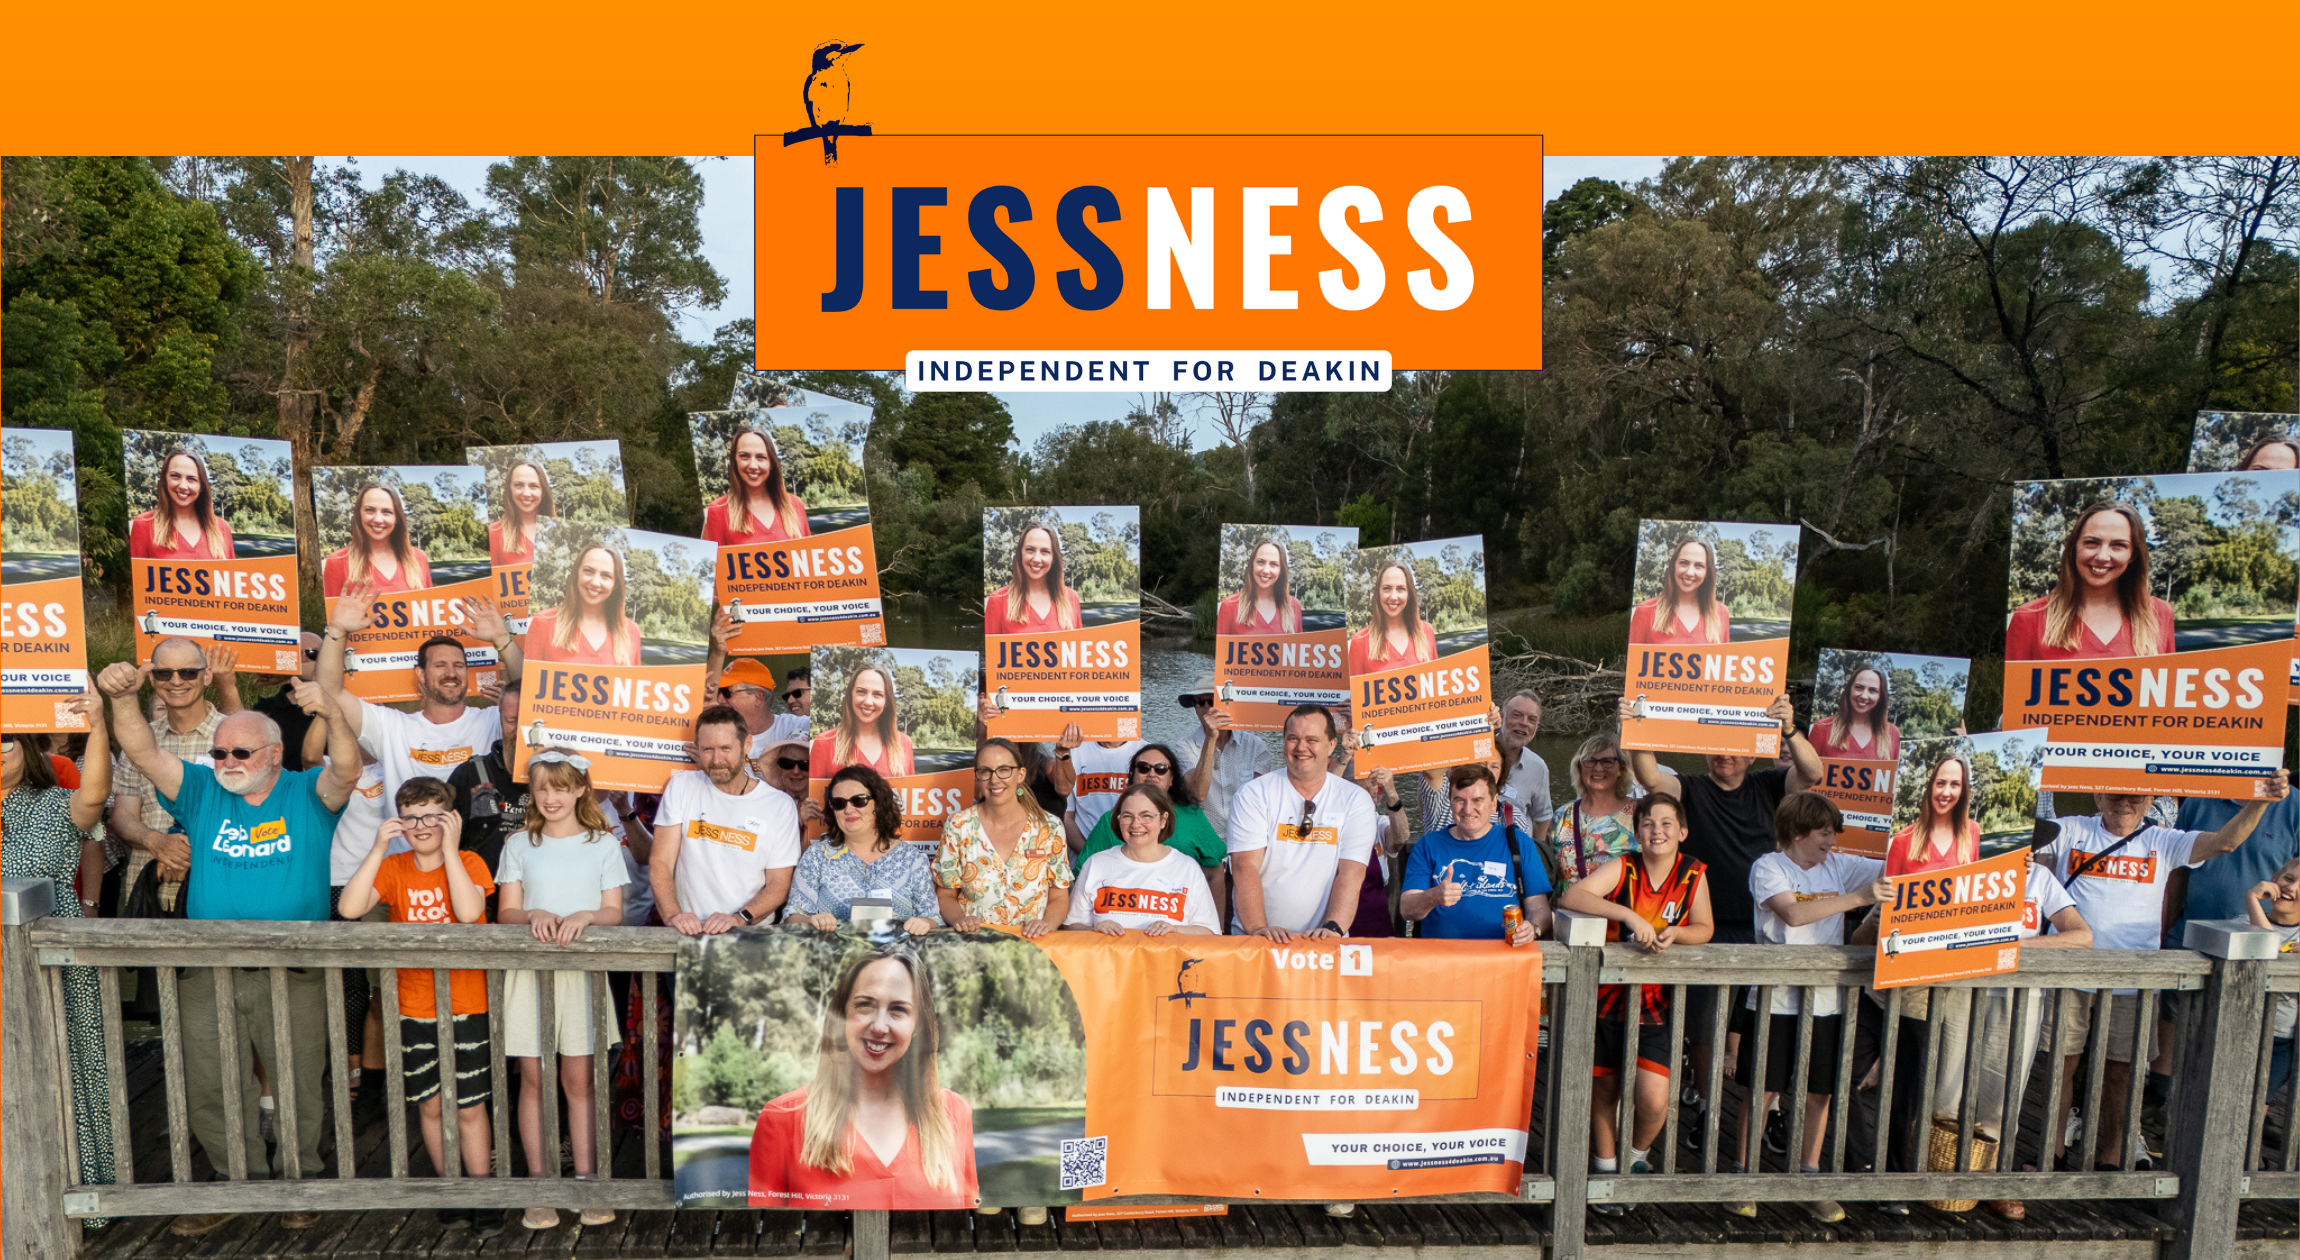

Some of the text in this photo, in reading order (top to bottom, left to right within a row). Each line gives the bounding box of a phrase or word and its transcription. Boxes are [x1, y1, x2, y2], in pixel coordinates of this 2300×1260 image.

[728, 578, 867, 593] INDEPENDENT FOR DEAKIN
[145, 596, 288, 613] INDEPENDENT FOR DEAKIN
[774, 606, 811, 614] CHOICE,
[813, 604, 839, 612] YOUR
[191, 623, 228, 632] CHOICE,
[348, 632, 420, 642] NDEPENDENT
[423, 630, 443, 639] FOR
[14, 643, 70, 652] DEAKIN
[360, 656, 387, 664] YOUR
[997, 672, 1068, 680] INDEPENDENT
[1070, 672, 1090, 680] FOR
[1224, 669, 1286, 677] INDEPENDENT
[1289, 670, 1306, 678] FOR
[1636, 681, 1773, 695] INDEPENDENT FOR DEAKIN
[1362, 695, 1482, 719] INDEPENDENT FOR DEAKIN
[1677, 706, 1713, 715] CHOICE,
[533, 704, 690, 727] INDEPENDENT FOR DEAKIN
[2023, 713, 2263, 729] INDEPENDENT FOR DEAKIN
[1376, 718, 1483, 738] YOUR CHOICE, YOUR VOICE
[548, 733, 577, 742] YOUR
[581, 735, 622, 747] CHOICE,
[626, 740, 654, 750] YOUR
[2045, 747, 2261, 761] YOUR CHOICE, YOUR VOICE
[1847, 814, 1880, 823] CHOICE,
[256, 827, 278, 838] Vote
[1891, 901, 2015, 924] INDEPENDENT FOR DEAKIN
[1902, 926, 2012, 945] YOUR CHOICE, YOUR VOICE
[1271, 949, 1334, 970] Vote
[1222, 1092, 1414, 1105] INDEPENDENT FOR DEAKIN
[1332, 1138, 1506, 1153] YOUR CHOICE, YOUR VOICE
[683, 1190, 720, 1200] Authorised
[722, 1190, 731, 1198] by
[732, 1190, 747, 1198] Jess
